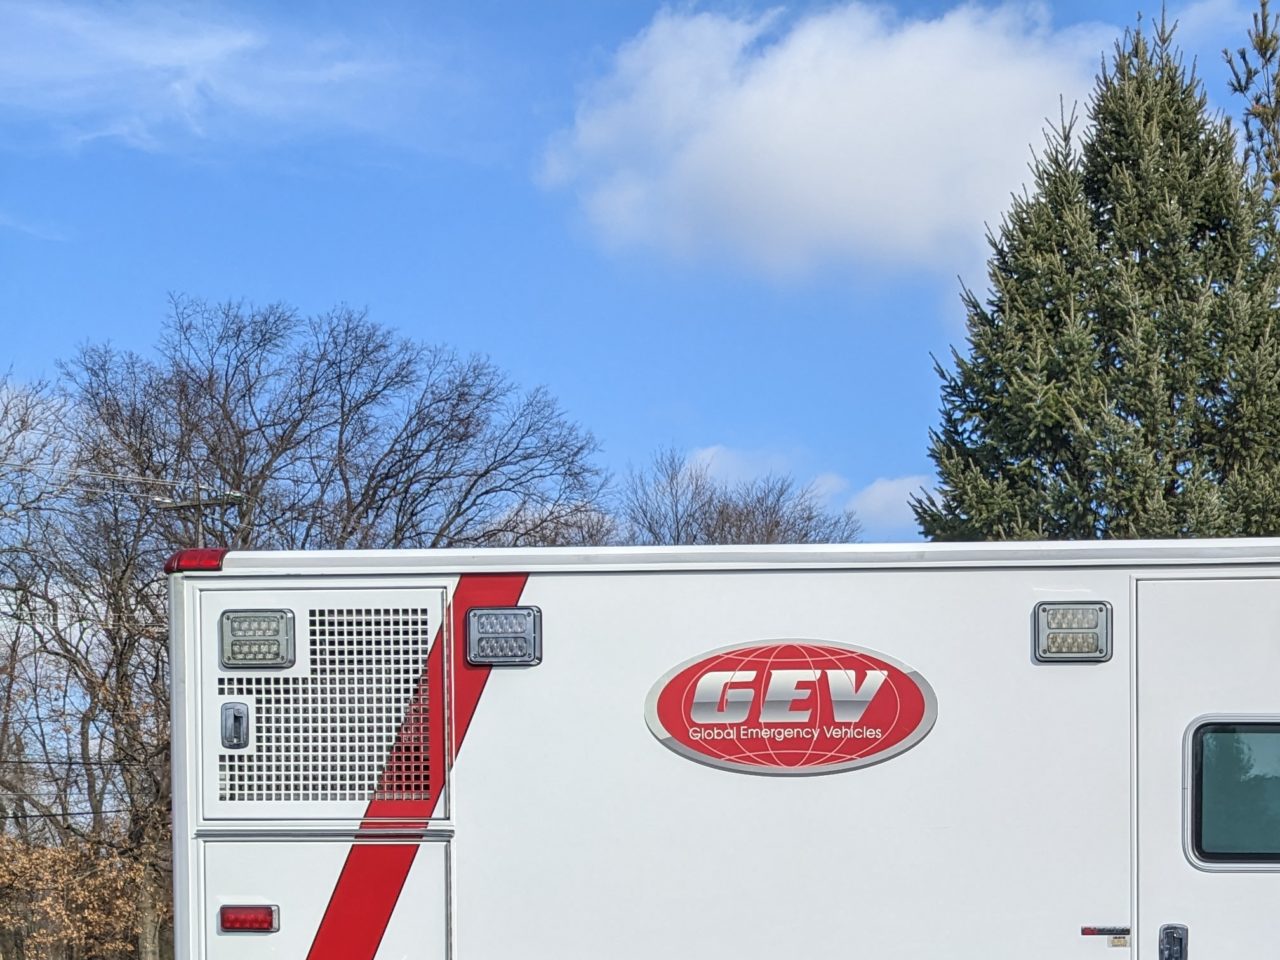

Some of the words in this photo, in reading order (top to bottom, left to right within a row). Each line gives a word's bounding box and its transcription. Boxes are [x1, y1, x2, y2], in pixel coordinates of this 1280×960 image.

[690, 669, 889, 724] GEV
[688, 726, 737, 740] Global
[740, 726, 820, 741] Emergency
[823, 726, 882, 740] Vehicles
